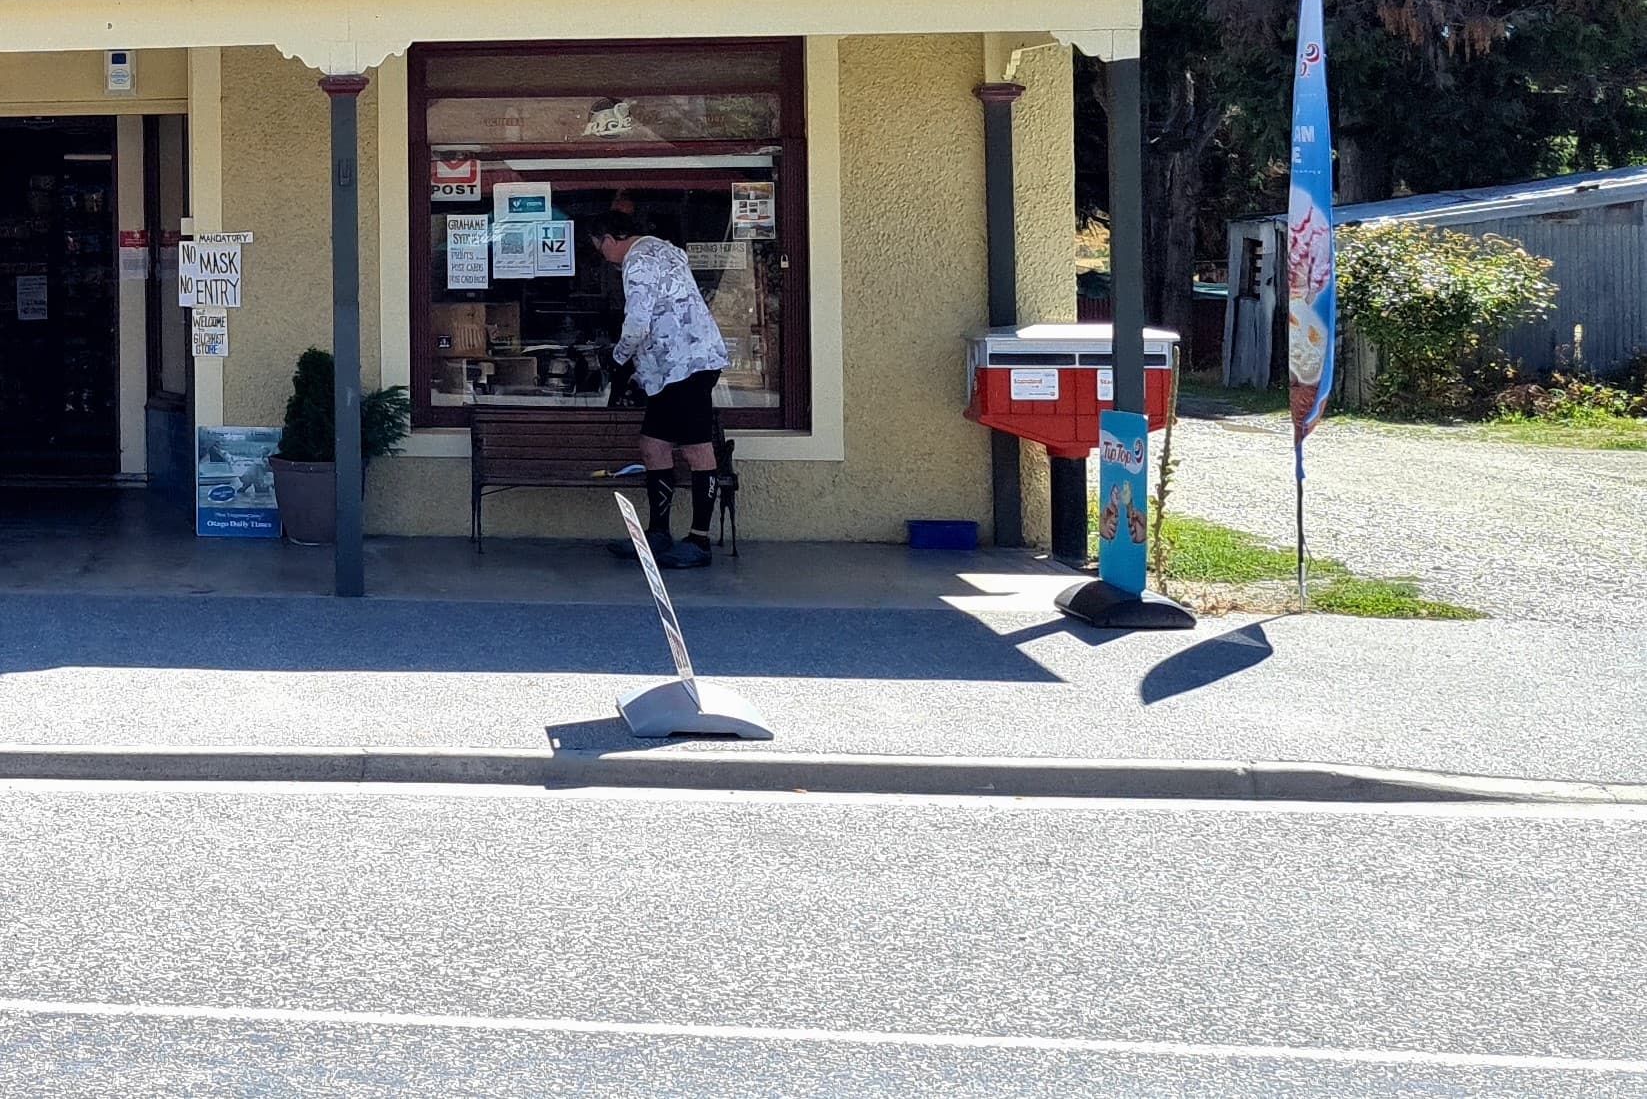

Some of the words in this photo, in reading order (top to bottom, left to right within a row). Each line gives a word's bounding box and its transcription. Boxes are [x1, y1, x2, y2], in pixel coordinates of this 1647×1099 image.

[431, 185, 477, 195] POST
[199, 234, 248, 242] MANDATORY
[542, 240, 566, 253] NZ
[182, 244, 196, 264] NO
[200, 252, 238, 274] MASK
[180, 274, 193, 294] NO
[196, 278, 239, 305] ENTRY
[193, 315, 226, 328] WELCOME
